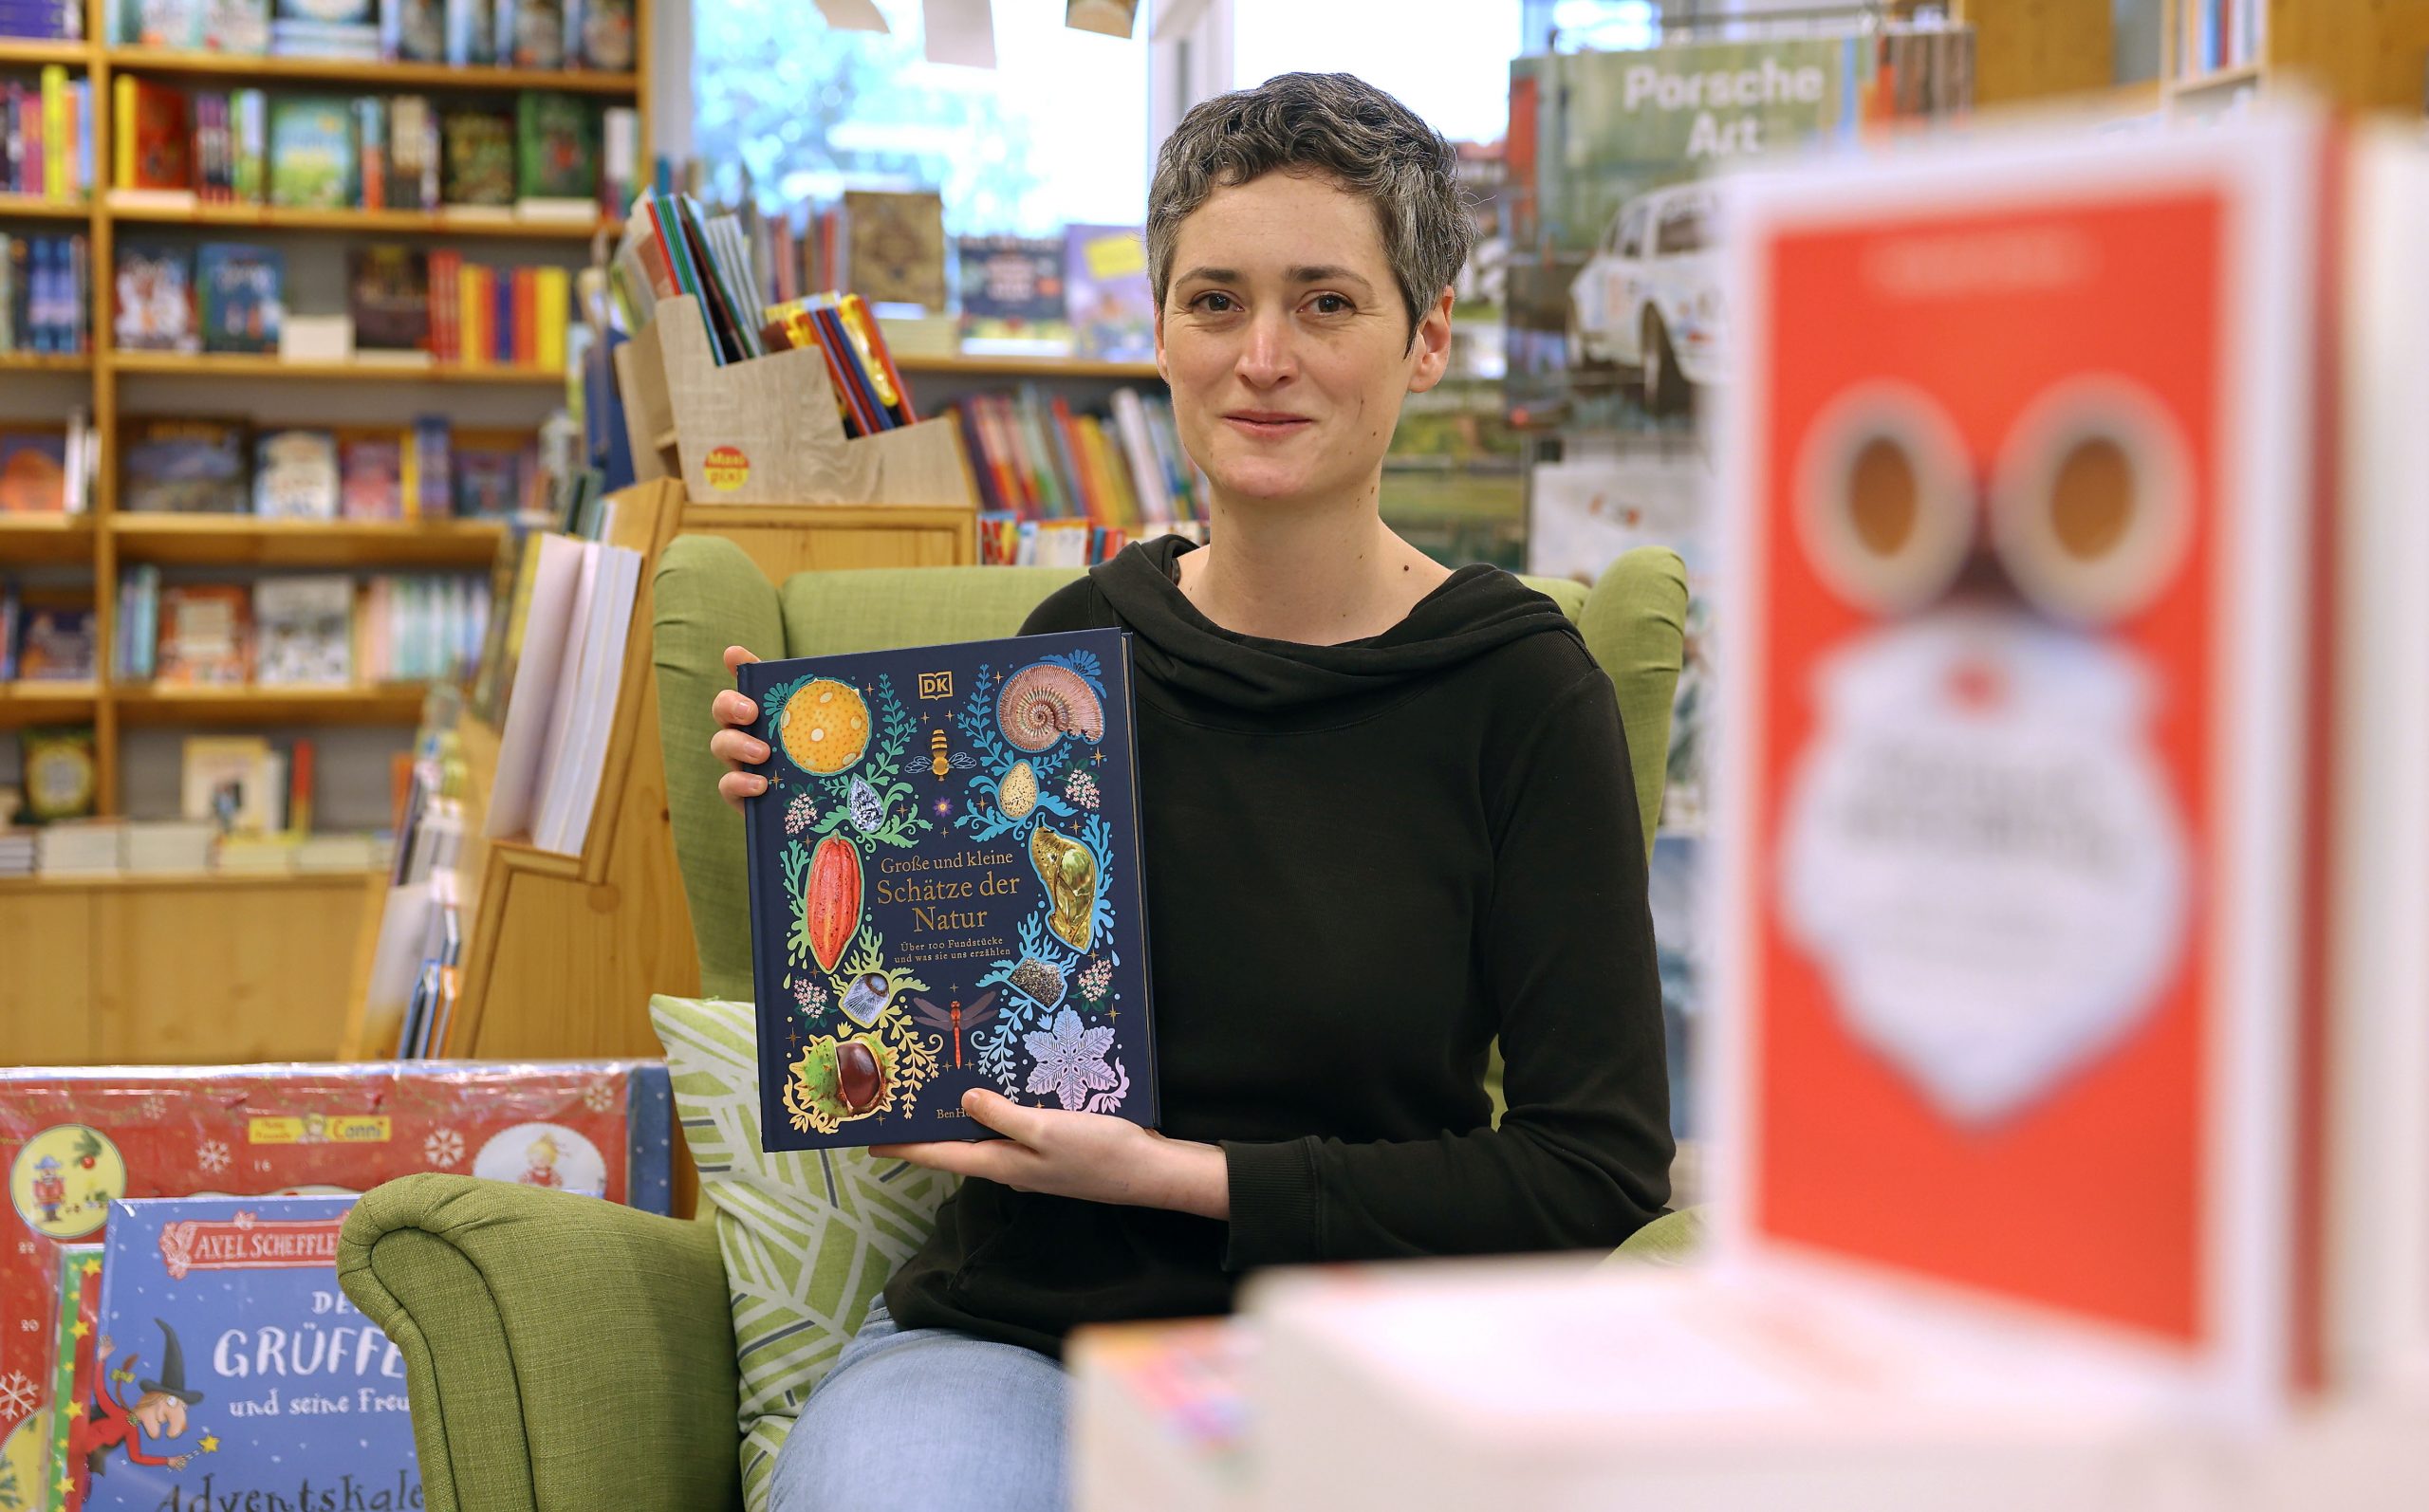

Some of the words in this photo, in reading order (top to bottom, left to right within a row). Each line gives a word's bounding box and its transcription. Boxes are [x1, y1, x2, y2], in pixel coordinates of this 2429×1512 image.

[1623, 57, 1824, 112] Porsche
[1686, 111, 1762, 159] Art
[923, 677, 949, 693] DK
[881, 856, 930, 874] Große
[933, 851, 963, 869] und
[966, 849, 1013, 867] kleine
[877, 877, 973, 904] Schätze
[979, 870, 1020, 896] der
[911, 906, 988, 932] Natur
[894, 954, 912, 964] und
[935, 951, 948, 961] sie
[951, 951, 967, 960] uns
[970, 947, 1011, 958] erzählen
[900, 941, 925, 951] Über
[928, 941, 945, 950] 100
[948, 936, 1004, 949] Fundstücke
[936, 1109, 955, 1119] Ben
[333, 1118, 384, 1139] Conni
[194, 1235, 248, 1260] AXEL
[250, 1232, 339, 1259] SCHEFFLE
[311, 1290, 361, 1315] DE
[229, 1387, 281, 1417] und
[288, 1392, 350, 1416] seine
